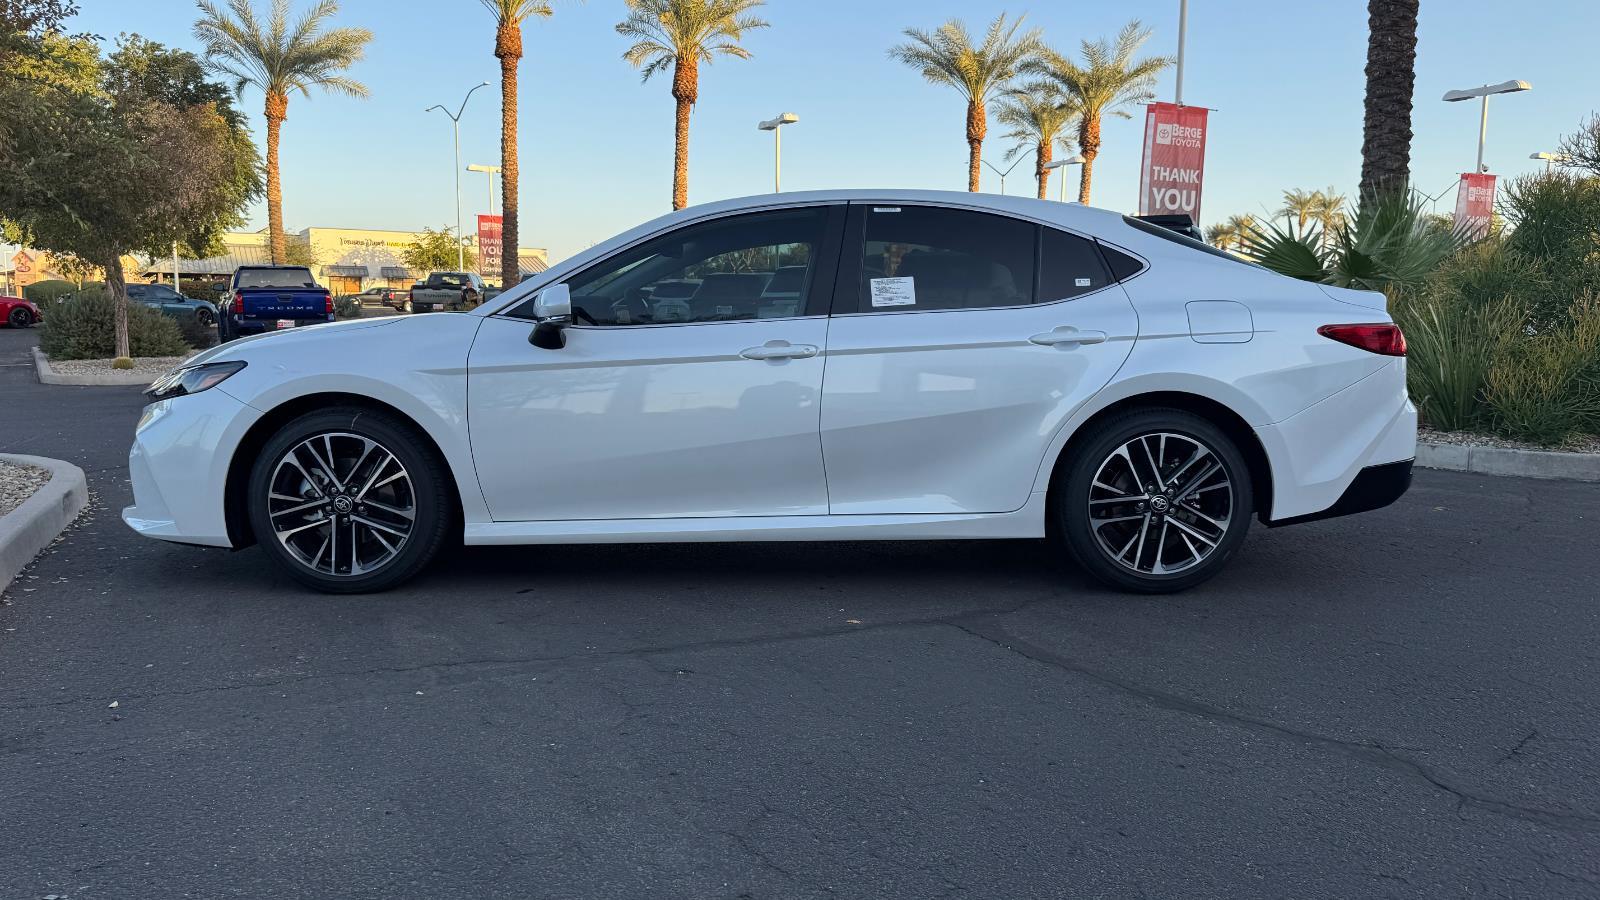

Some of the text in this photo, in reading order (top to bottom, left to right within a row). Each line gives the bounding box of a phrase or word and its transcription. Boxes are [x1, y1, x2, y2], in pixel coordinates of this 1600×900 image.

[1171, 124, 1203, 138] BERGE
[1171, 137, 1201, 148] TOYOTA
[1152, 166, 1199, 183] THANK
[1152, 187, 1197, 211] YOU
[482, 246, 503, 255] YOU
[485, 257, 501, 265] FOR
